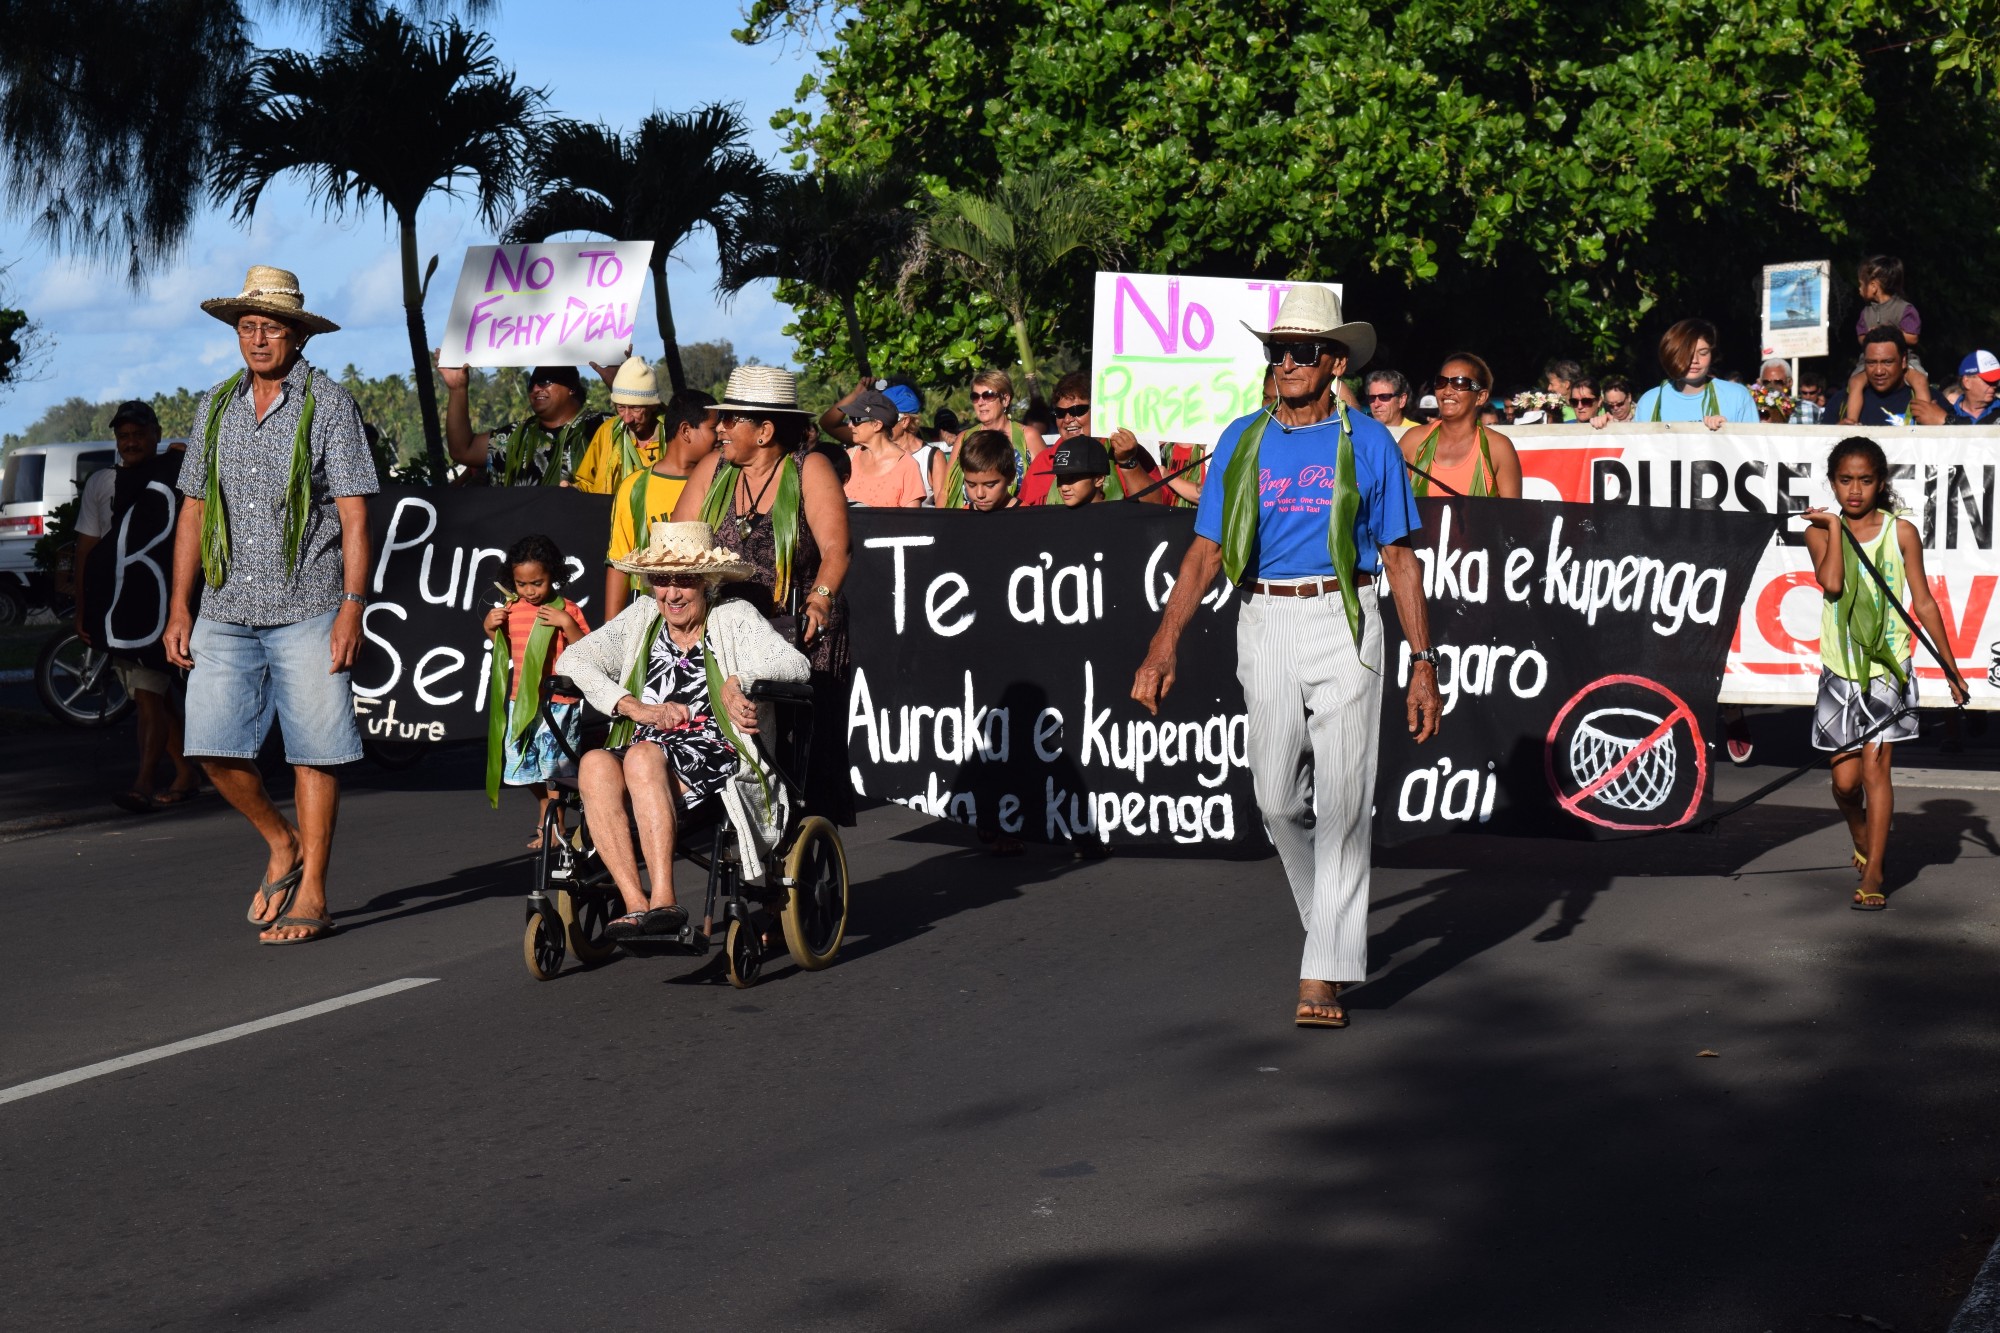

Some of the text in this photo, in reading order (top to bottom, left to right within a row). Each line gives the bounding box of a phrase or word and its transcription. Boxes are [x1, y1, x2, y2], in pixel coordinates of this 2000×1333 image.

[465, 294, 555, 354] FISHY
[1245, 282, 1294, 332] T
[864, 536, 977, 636] Te
[1505, 547, 1534, 601] e
[1544, 515, 1727, 636] kupenga
[353, 695, 447, 741] Future
[847, 660, 1250, 788] Auraka e kupenga
[1045, 776, 1234, 844] kupenga
